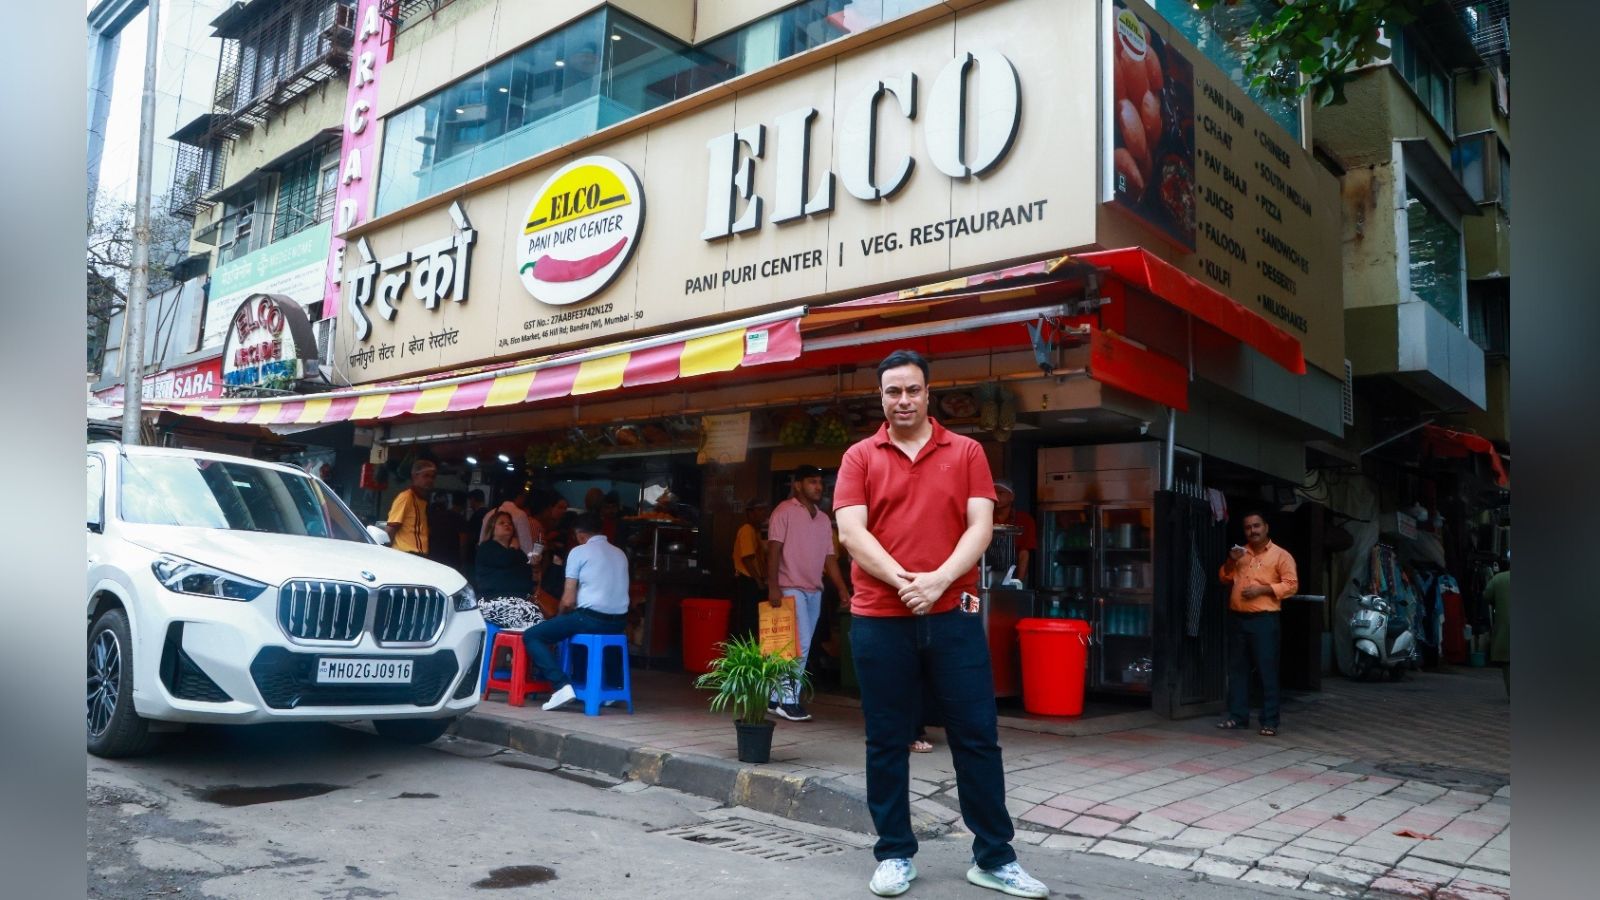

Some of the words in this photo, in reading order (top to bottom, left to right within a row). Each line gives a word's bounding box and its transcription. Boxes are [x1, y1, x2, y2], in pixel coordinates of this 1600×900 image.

[1203, 82, 1224, 111] PANI
[1225, 99, 1245, 128] PURI
[700, 49, 1022, 243] ELCO
[1204, 149, 1221, 175] PAV
[1260, 131, 1291, 170] CHINESE
[550, 183, 601, 222] ELCO
[1205, 187, 1234, 220] JUICES
[1260, 162, 1285, 195] SOUTH
[1286, 183, 1312, 217] INDIAN
[1261, 194, 1282, 224] PIZZA
[528, 234, 551, 255] PANI
[553, 226, 577, 248] PURI
[579, 214, 623, 240] CENTER
[684, 275, 718, 296] PANI
[721, 263, 756, 287] PURI
[760, 249, 823, 279] CENTER
[860, 232, 903, 257] VEG.
[909, 200, 1049, 247] RESTAURANT
[1205, 222, 1247, 264] FALOODA
[1261, 227, 1309, 275] SANDWICHES
[1205, 258, 1231, 288] KULFI
[1262, 260, 1297, 296] DESSERTS
[235, 297, 285, 345] ELCO
[521, 331, 541, 343] Market,
[541, 329, 549, 338] 46
[549, 327, 559, 337] Hill
[569, 322, 590, 333] Bandra
[604, 312, 630, 325] Mumbai
[634, 310, 644, 320] 50
[523, 319, 536, 331] GST
[536, 317, 549, 328] No.:
[1262, 294, 1308, 334] MILKSHAKES
[349, 345, 375, 370] पानीपुरी
[378, 342, 396, 361] सेंटर
[408, 335, 425, 355] व्हेज
[174, 371, 213, 399] SARA
[328, 662, 410, 679] MH02GJ0916
